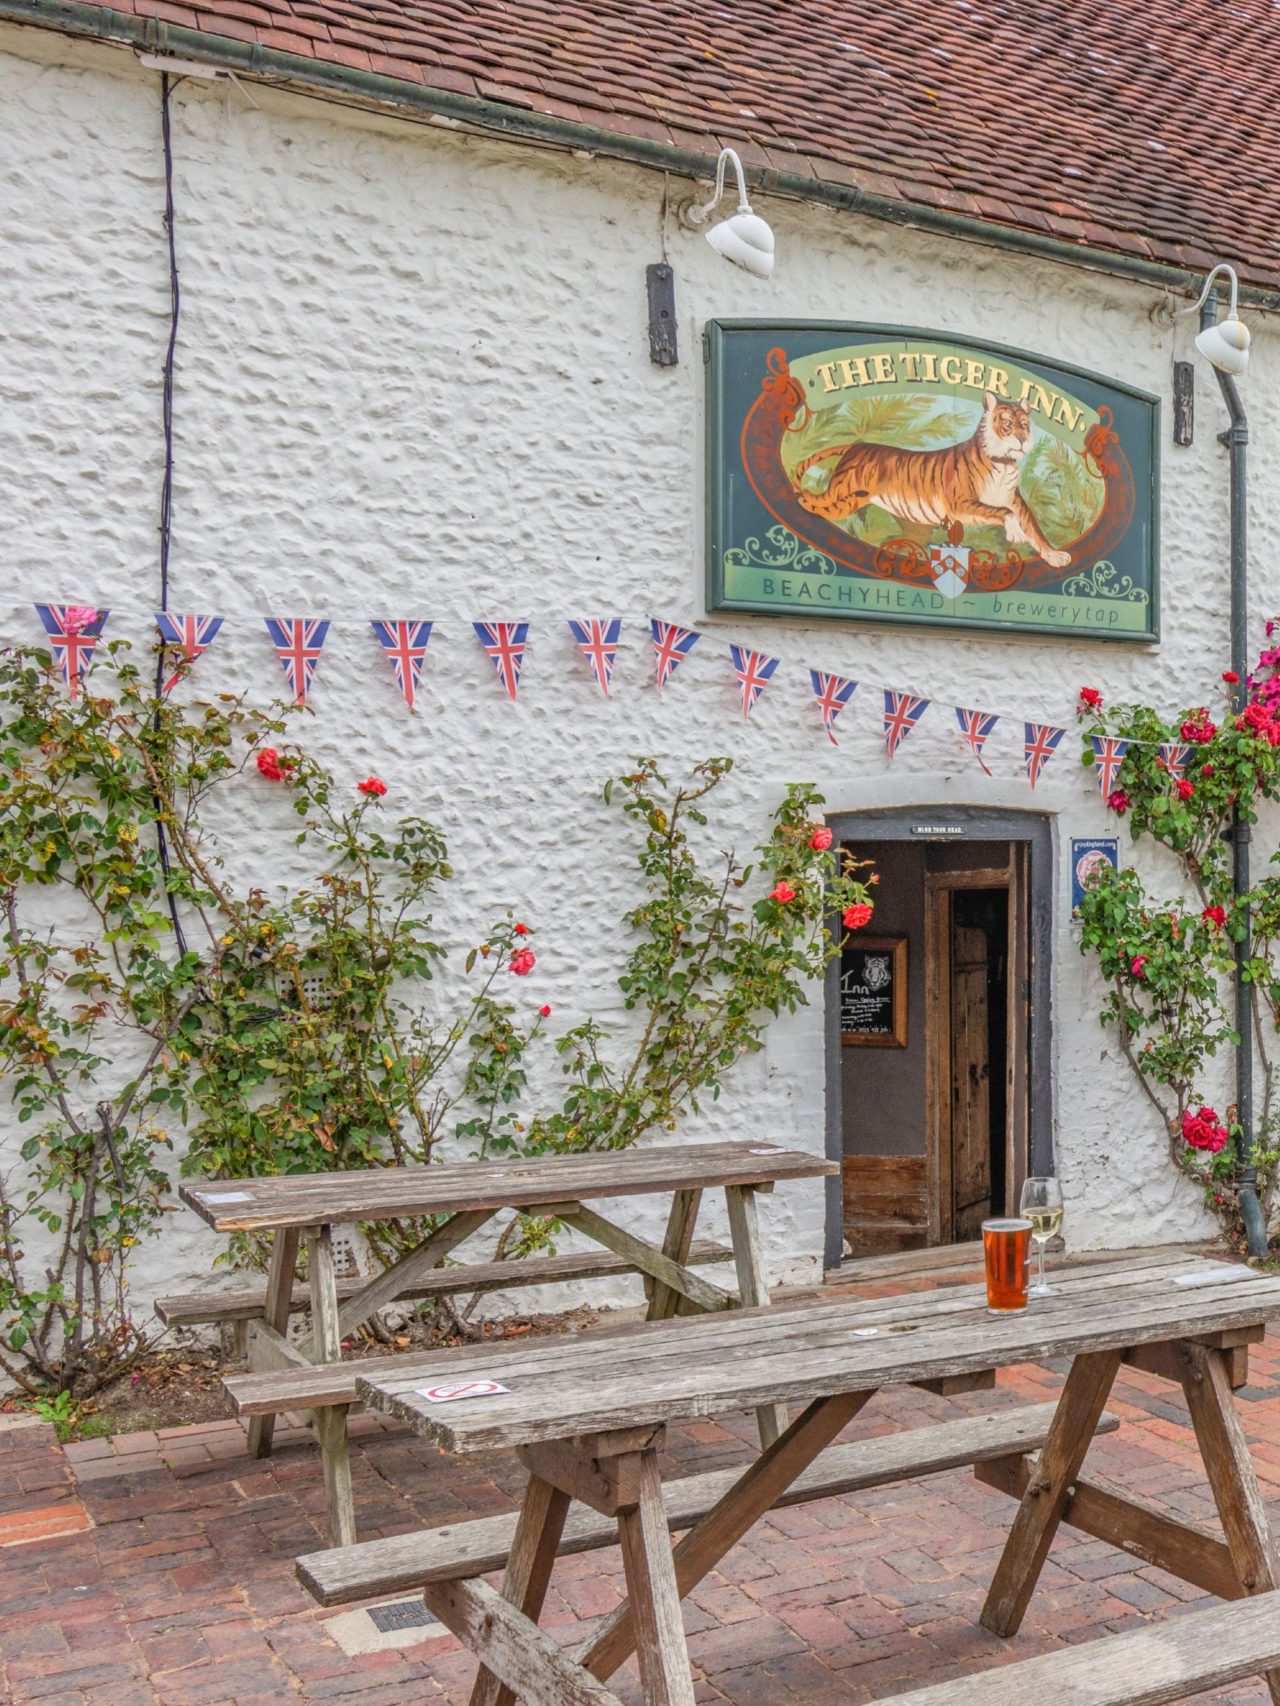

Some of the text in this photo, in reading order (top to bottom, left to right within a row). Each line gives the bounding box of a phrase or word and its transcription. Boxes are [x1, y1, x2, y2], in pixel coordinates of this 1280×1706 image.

[815, 353, 1084, 432] THE TIGER INN
[763, 578, 1118, 625] BEACHYHEAD brewerytap
